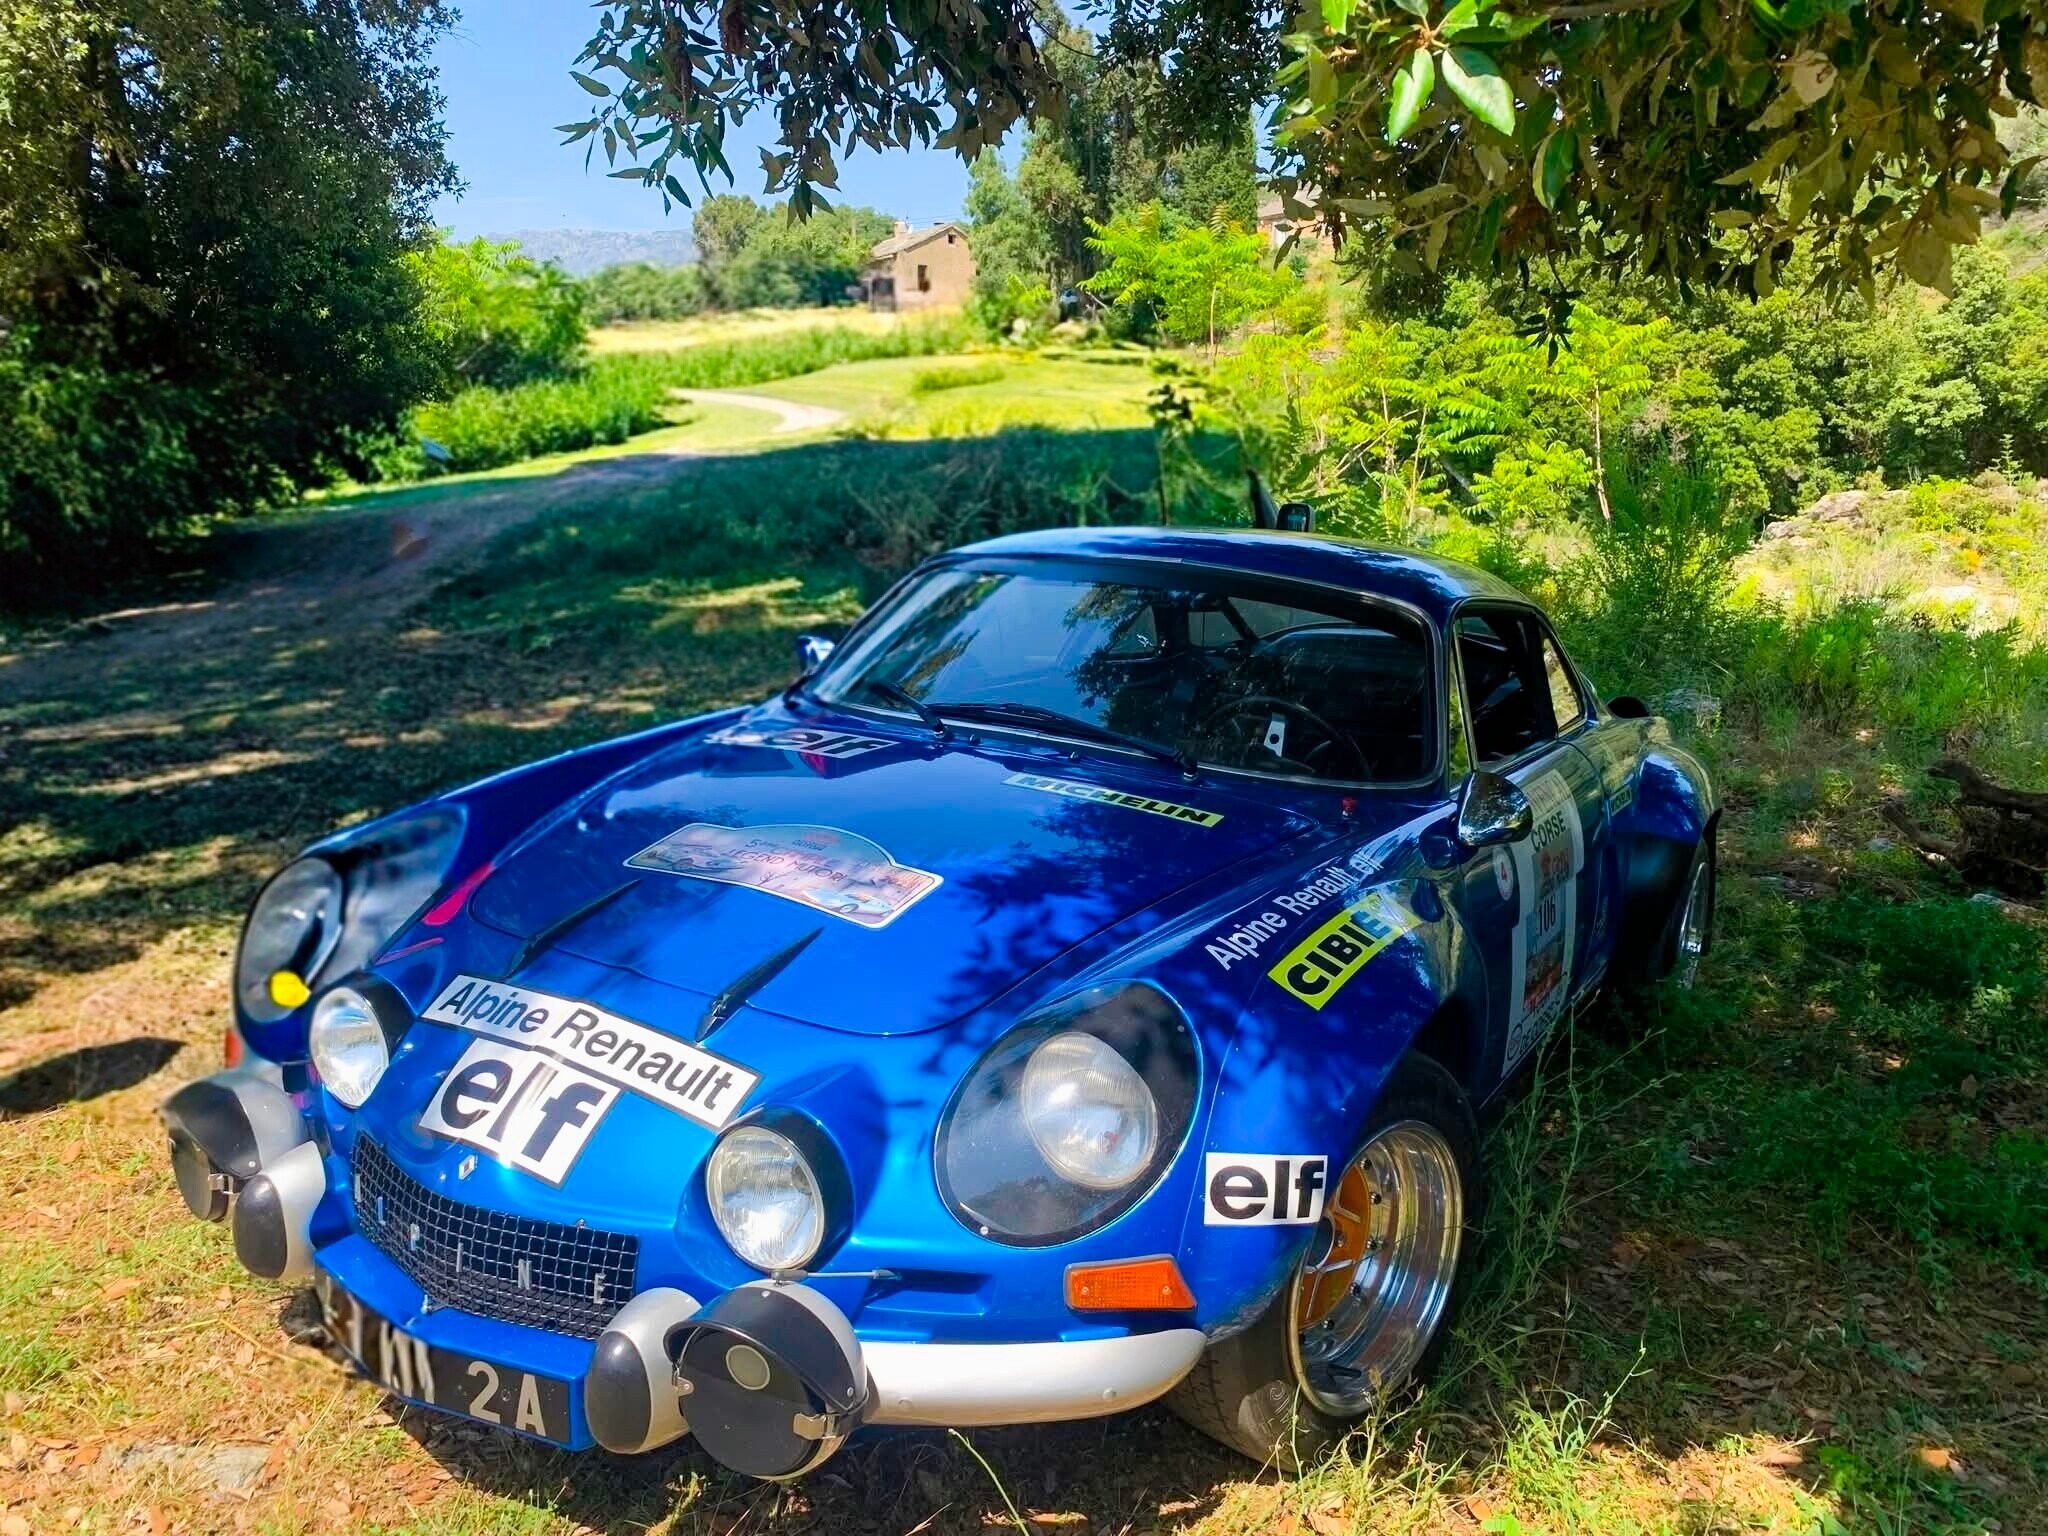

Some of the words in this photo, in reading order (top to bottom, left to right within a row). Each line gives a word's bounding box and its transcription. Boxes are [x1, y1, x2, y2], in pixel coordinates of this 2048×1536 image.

[1017, 776, 1210, 823] MICHELIN
[1531, 811, 1567, 851] CORSE
[1204, 911, 1288, 971] Alpine
[1272, 865, 1361, 916] Renault
[1536, 896, 1556, 937] 106
[439, 981, 550, 1033] Alpine
[551, 1008, 732, 1110] Renault
[440, 1058, 607, 1164] elf
[1210, 1160, 1324, 1220] elf
[468, 1360, 547, 1437] 2A
